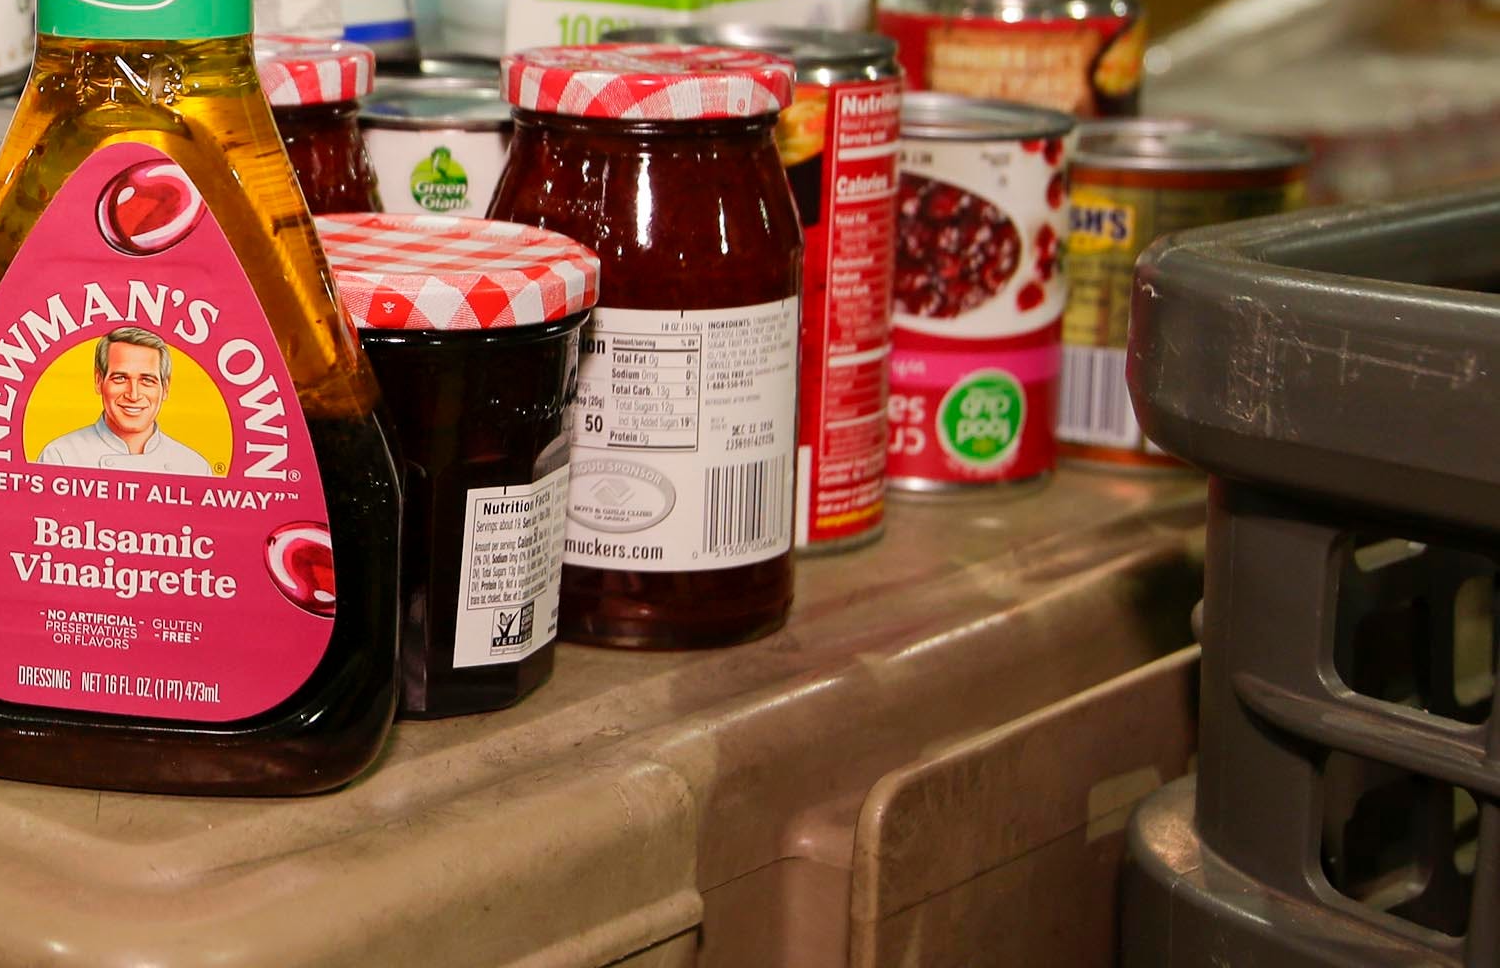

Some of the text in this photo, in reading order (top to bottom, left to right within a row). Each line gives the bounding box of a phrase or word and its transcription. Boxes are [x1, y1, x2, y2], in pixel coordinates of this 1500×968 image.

[416, 182, 466, 194] Green
[837, 173, 889, 195] Calories
[421, 195, 467, 209] Giant
[612, 337, 656, 348] Amount/serving
[612, 353, 632, 364] Total
[634, 353, 646, 364] Fat
[611, 368, 640, 380] Sodium
[611, 383, 631, 394] Total
[632, 384, 653, 396] Carb.
[216, 338, 288, 481] OWN
[615, 399, 632, 410] Total
[634, 399, 658, 414] Sugars
[585, 414, 603, 433] 50
[957, 417, 1011, 445] food
[609, 430, 638, 442] Protein
[607, 460, 662, 485] SPONSOR
[52, 476, 109, 499] GIVE
[117, 482, 139, 501] IT
[147, 484, 193, 505] ALL
[483, 499, 534, 516] Nutrition
[574, 504, 593, 513] BOYS
[602, 508, 625, 516] GIRLS
[627, 509, 653, 518] CLUBS
[33, 516, 215, 560] Balsamic
[564, 538, 664, 560] muckers.com
[10, 551, 237, 599] Vinaigrette
[47, 609, 137, 628] NO ARTIFICIAL
[152, 618, 203, 632] GLUTEN
[45, 620, 138, 639] PRESERVATIVES
[162, 631, 192, 644] FREE
[53, 633, 130, 650] OR FLAVORS
[18, 665, 221, 703] DRESSING NET 16 FL. OZ. (1 PT) 473mL
